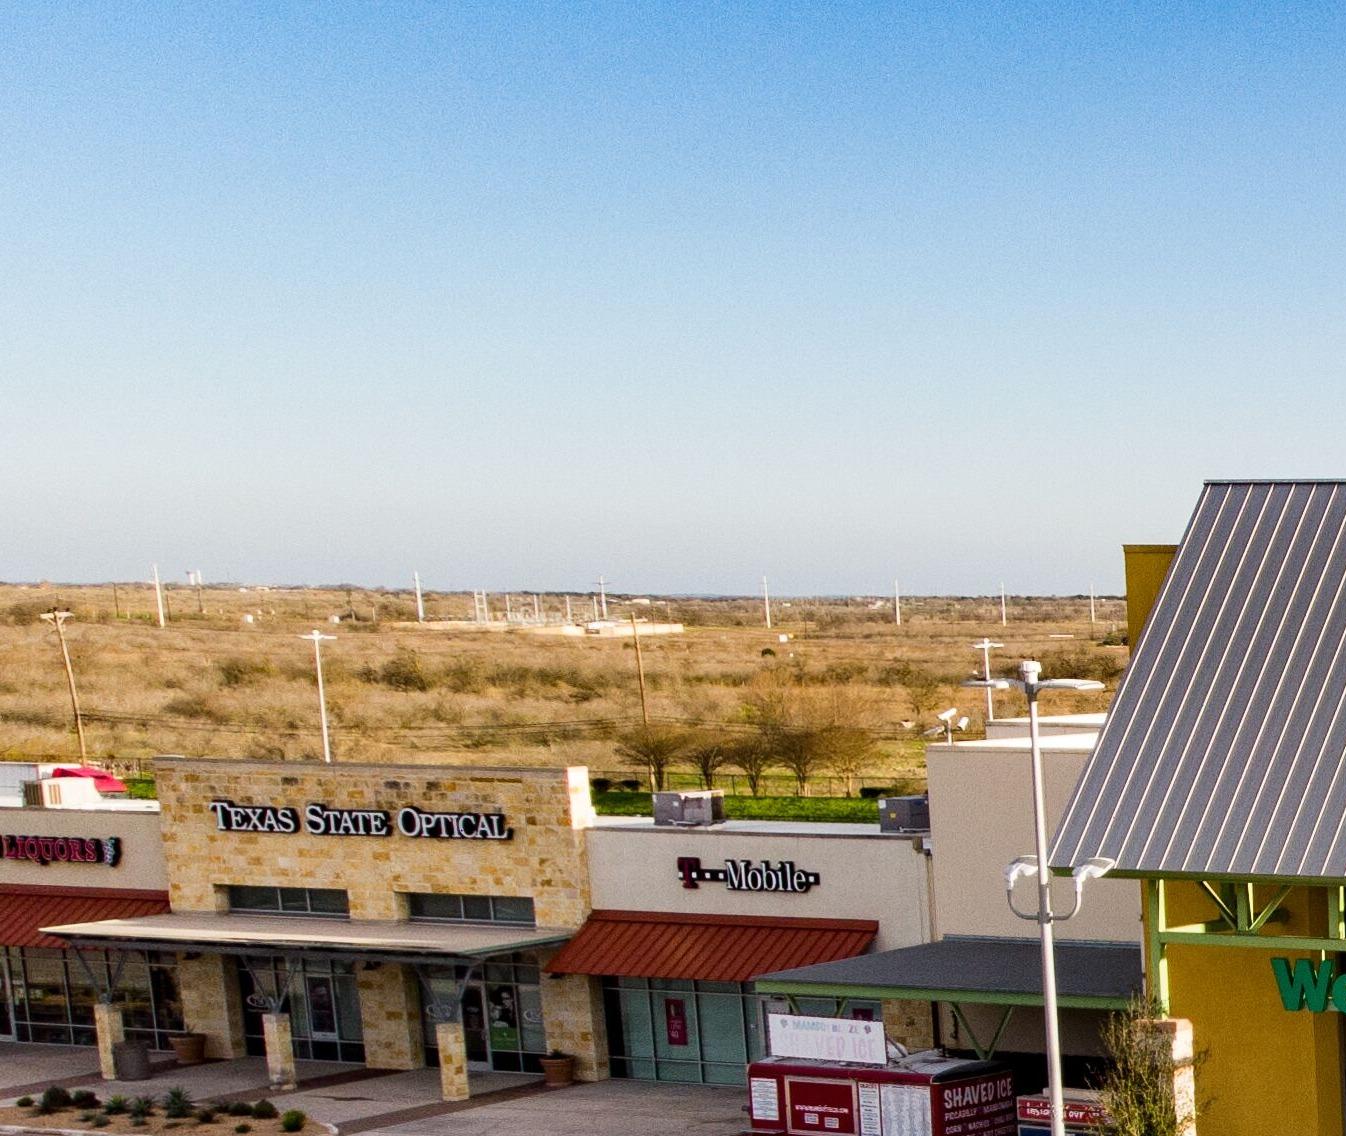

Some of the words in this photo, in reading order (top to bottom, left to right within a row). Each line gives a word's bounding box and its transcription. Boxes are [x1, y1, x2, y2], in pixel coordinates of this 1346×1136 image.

[209, 801, 297, 833] TEXAS
[305, 804, 389, 836] STATE
[397, 807, 510, 839] OPTICAL
[2, 836, 98, 865] LIQUORS
[943, 1082, 995, 1109] SHAVED
[996, 1078, 1012, 1099] ICE
